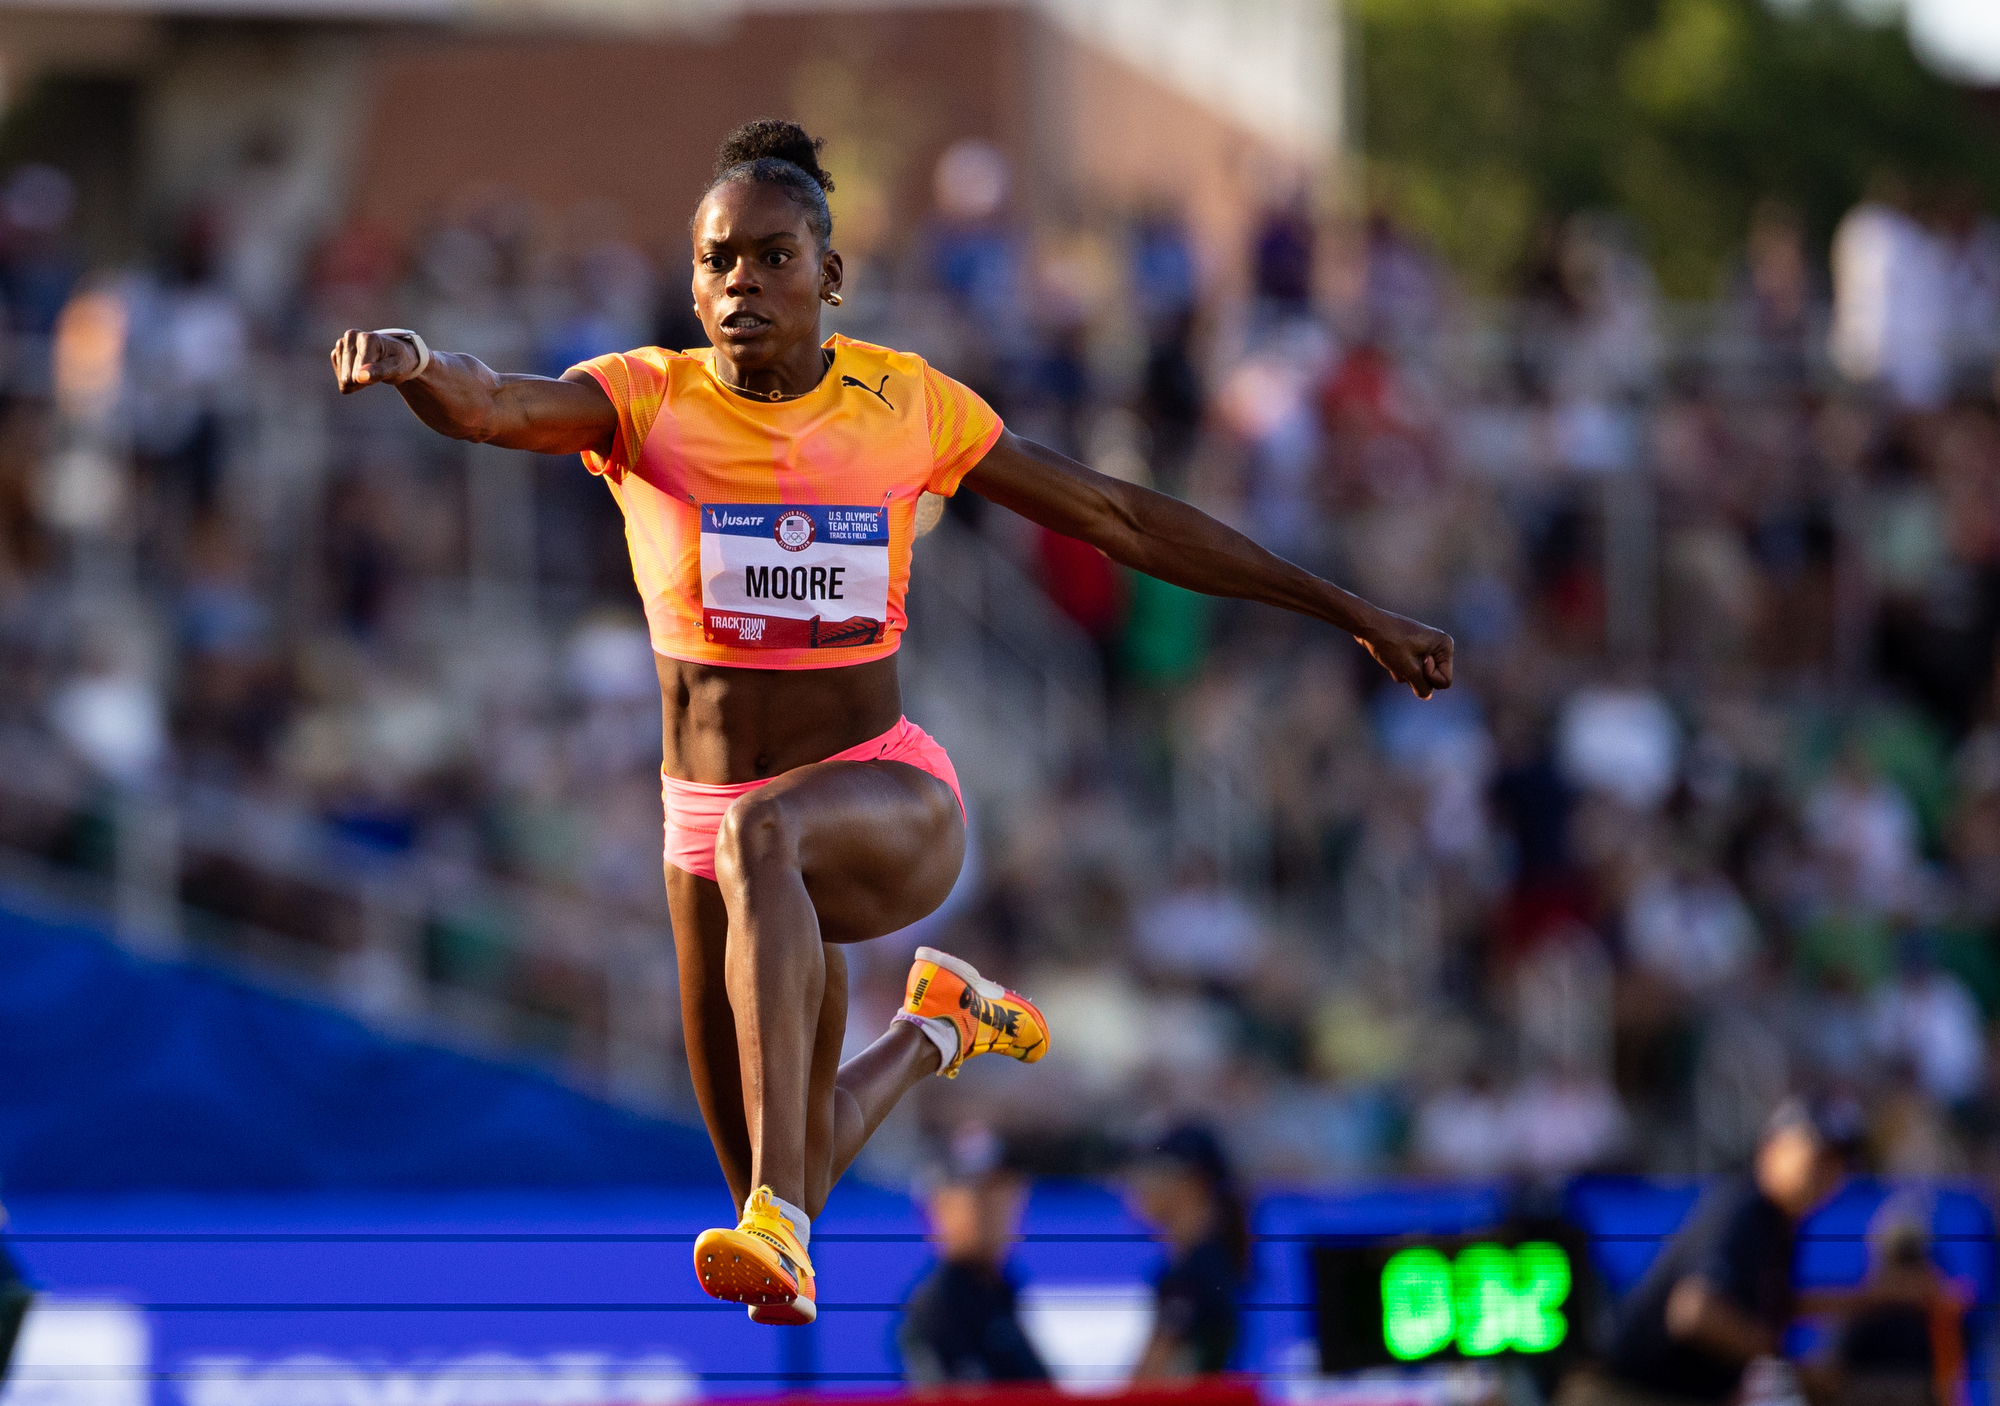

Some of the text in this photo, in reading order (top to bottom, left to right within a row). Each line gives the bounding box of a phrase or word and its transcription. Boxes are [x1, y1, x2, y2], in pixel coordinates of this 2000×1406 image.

[728, 516, 764, 526] USATF
[828, 511, 878, 522] U.S. OLYMPIC
[828, 521, 878, 532] TEAM TRIALS
[778, 540, 811, 551] OLYMPIC TEAM
[745, 565, 846, 601] MOORE
[710, 615, 766, 630] TRACKTOWN
[739, 628, 763, 640] 2024
[912, 977, 929, 1006] PUMA
